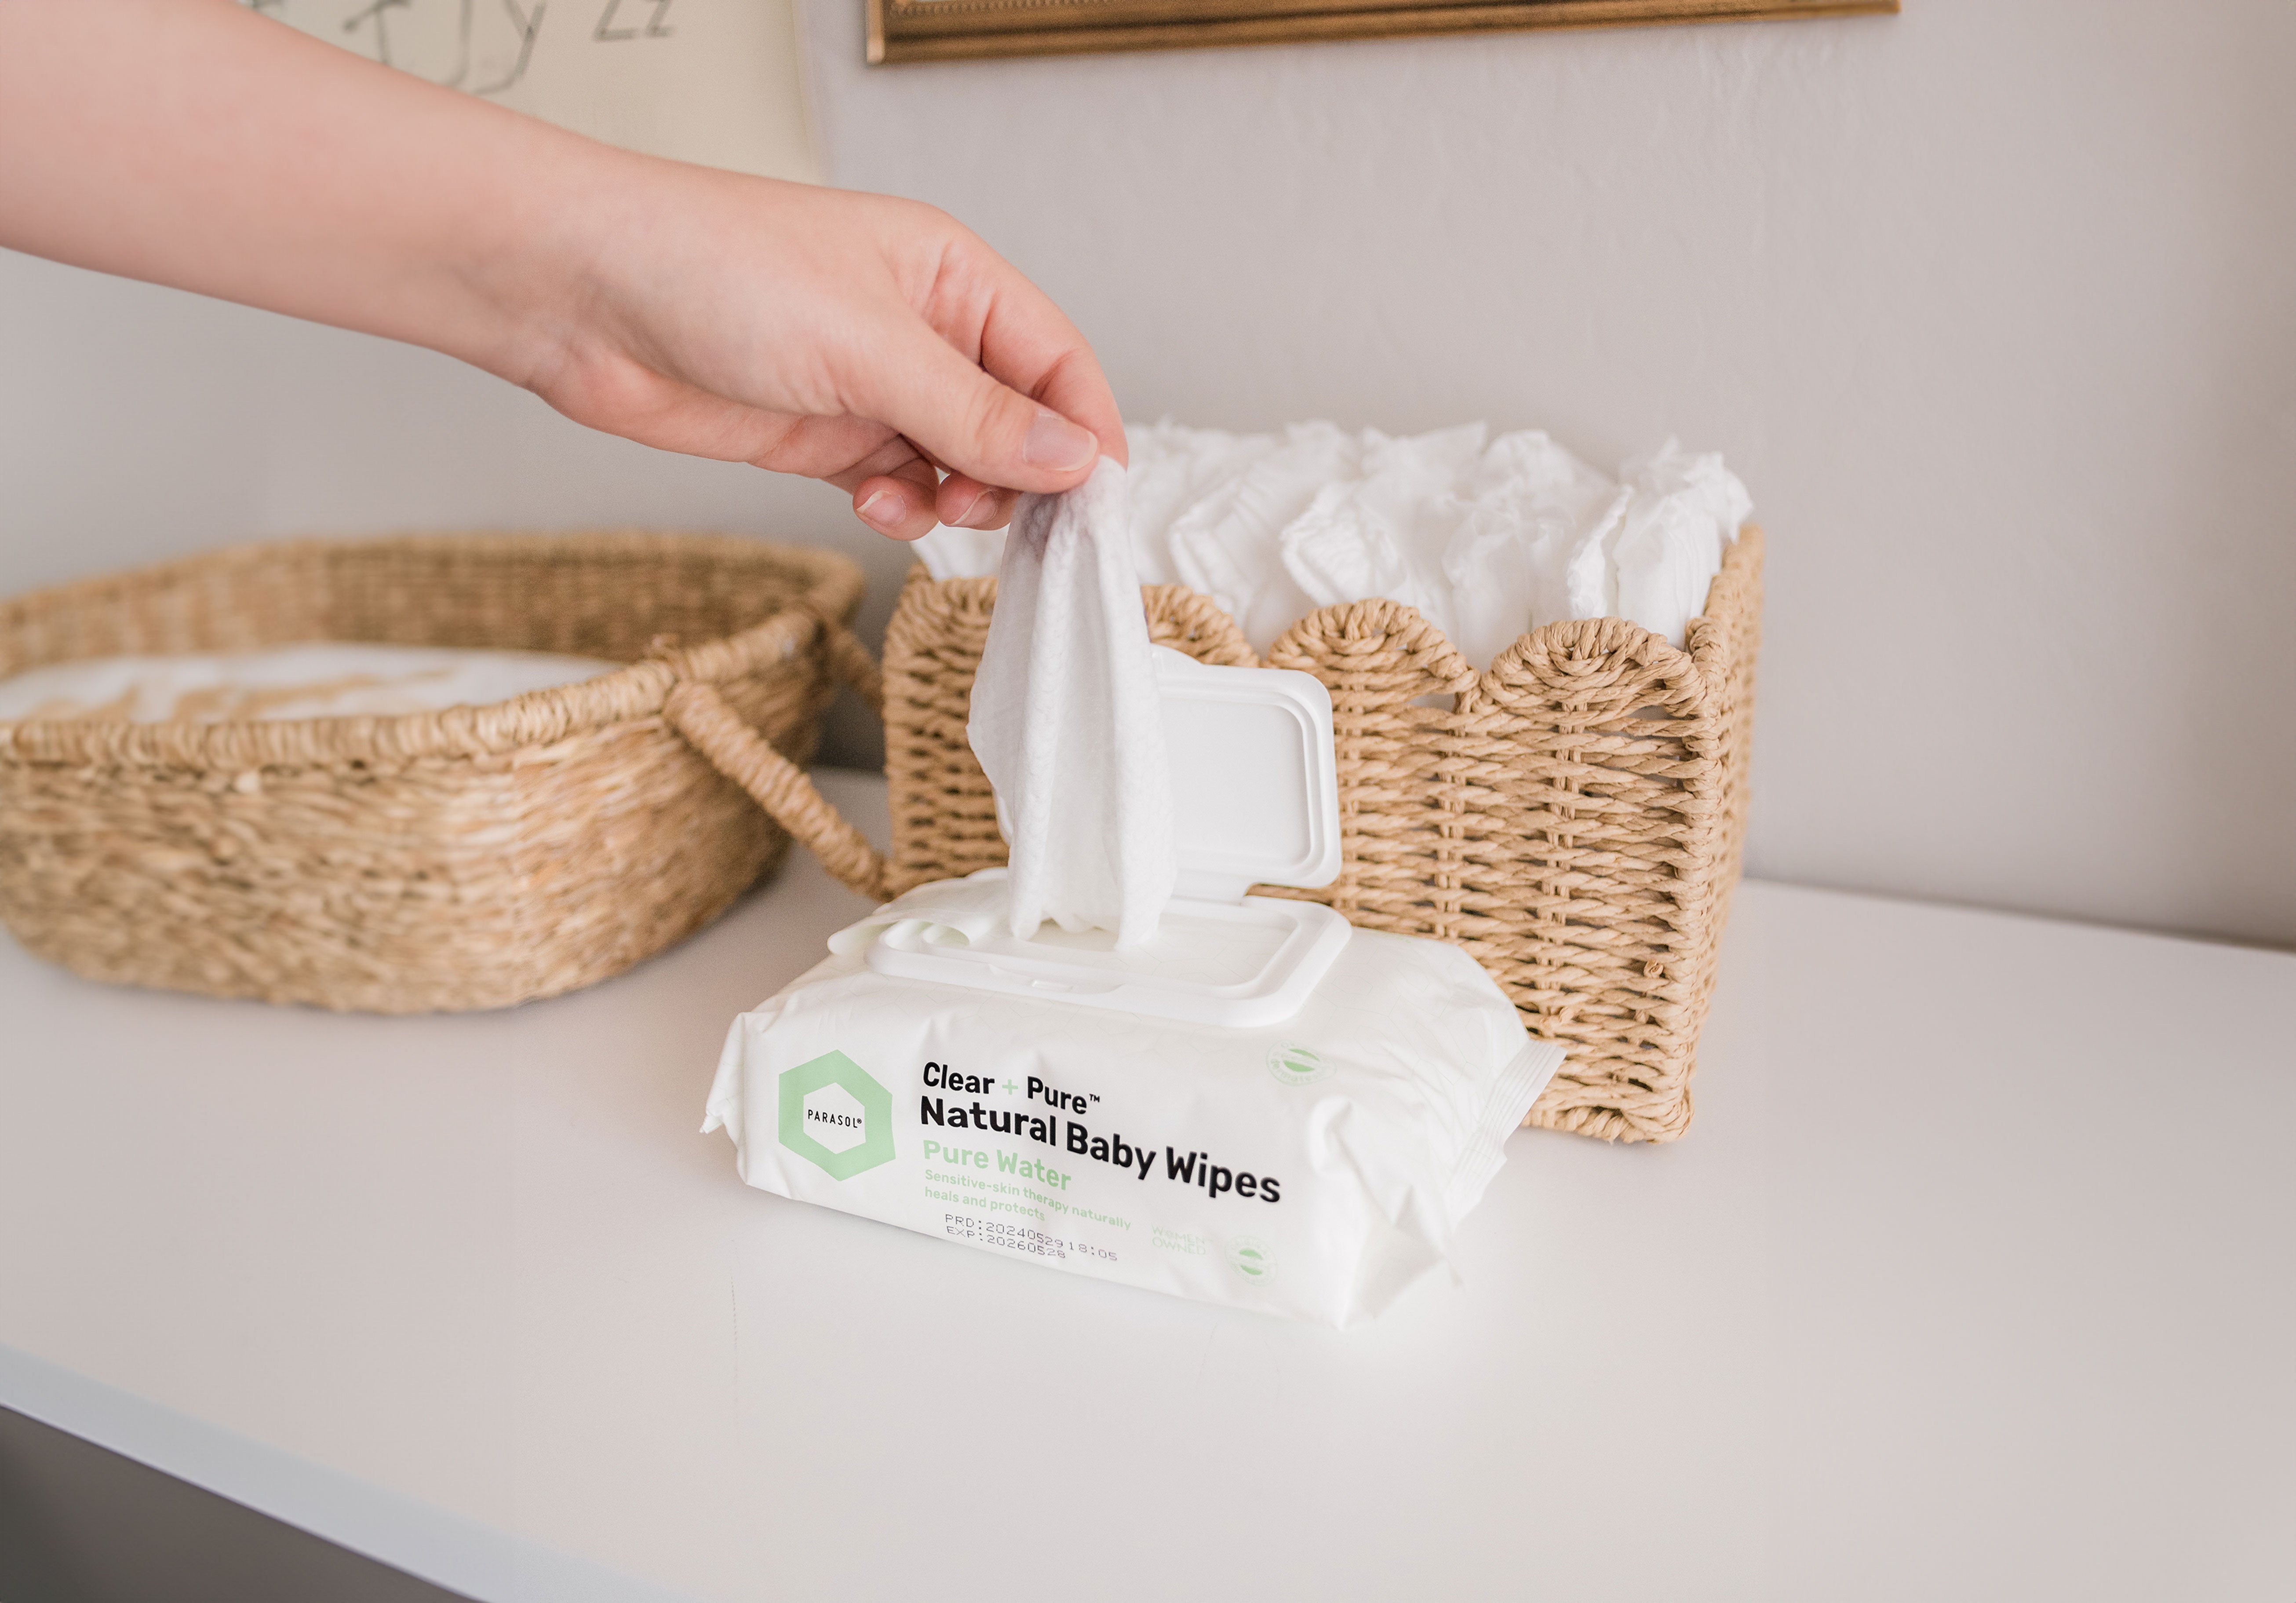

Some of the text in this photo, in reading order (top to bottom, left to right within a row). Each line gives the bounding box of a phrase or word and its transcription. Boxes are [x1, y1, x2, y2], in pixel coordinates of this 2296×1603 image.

[923, 1062, 995, 1094] Clear
[921, 1095, 1280, 1202] Natural Baby Wipes
[923, 1139, 1071, 1190] Pure Water
[925, 1169, 1131, 1231] Sensitive-skin therapy naturally
[925, 1187, 1045, 1221] heals and protects
[947, 1226, 1066, 1259] EXP:20260528
[1152, 1236, 1206, 1255] OWNED
